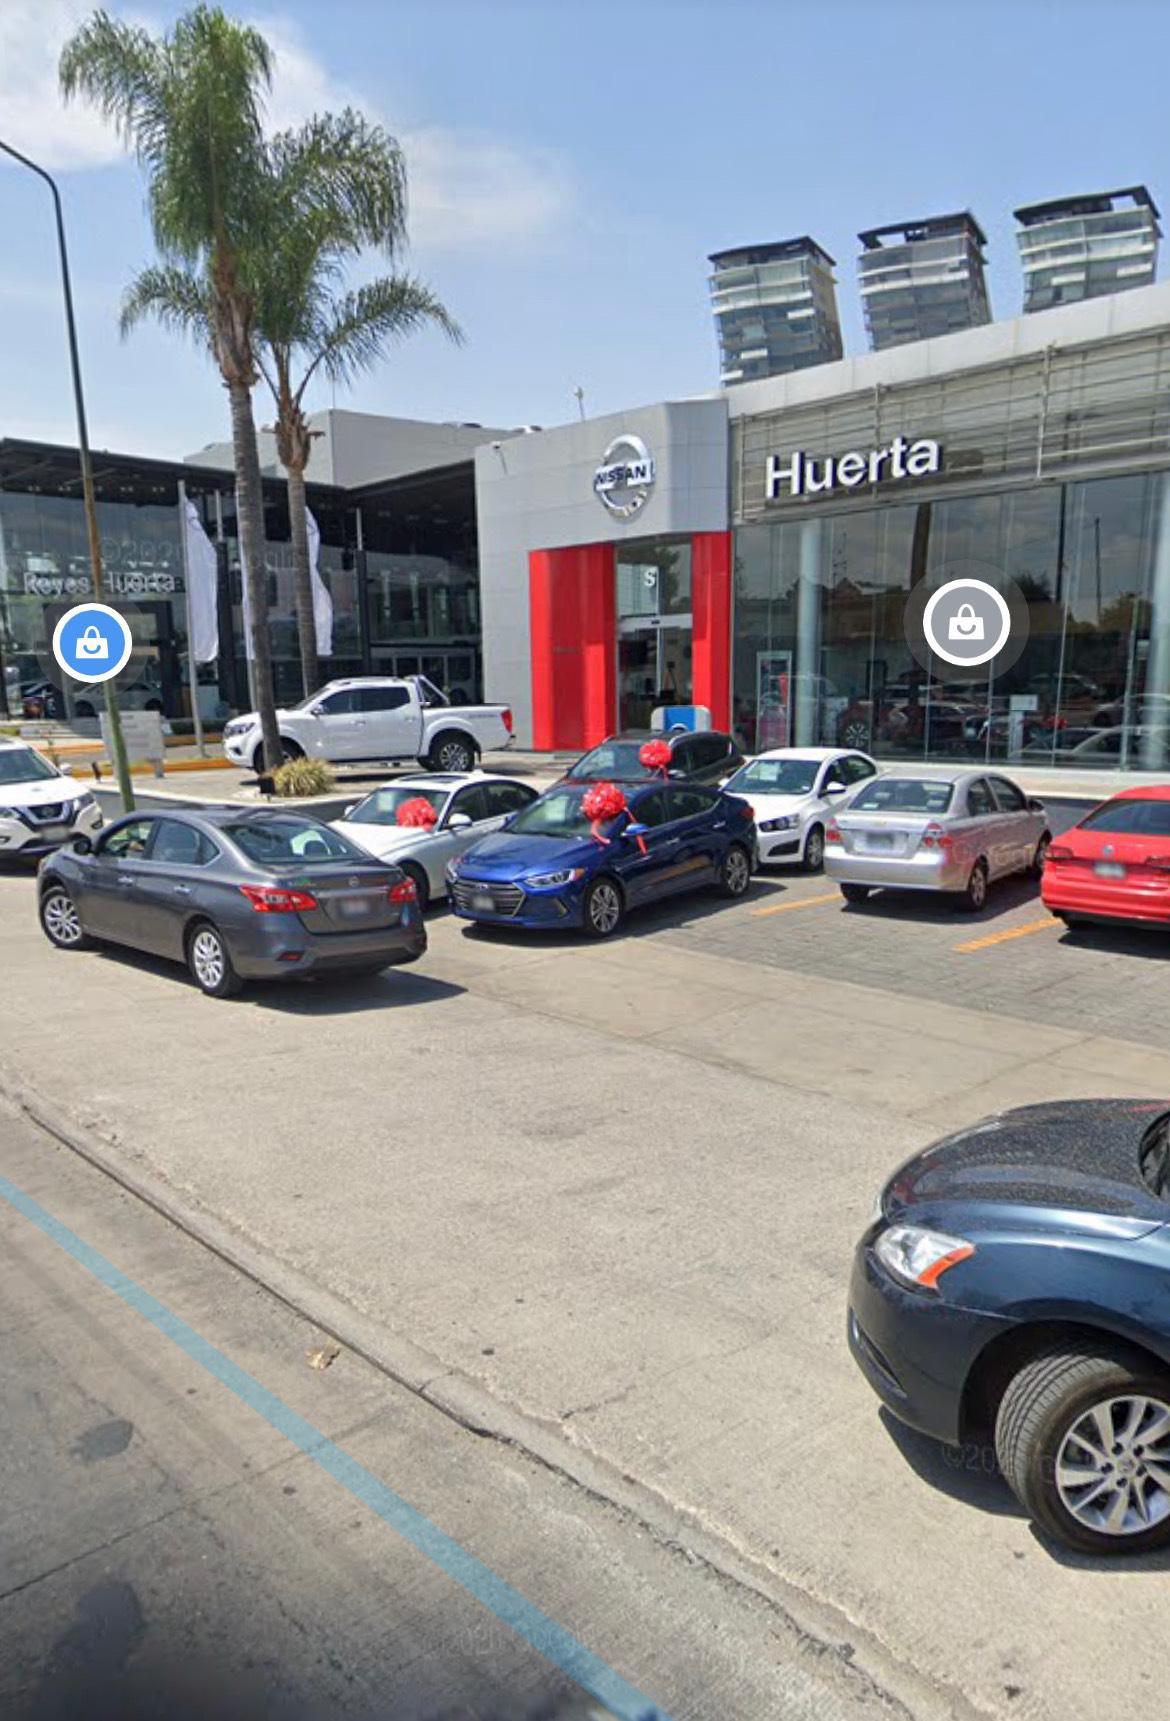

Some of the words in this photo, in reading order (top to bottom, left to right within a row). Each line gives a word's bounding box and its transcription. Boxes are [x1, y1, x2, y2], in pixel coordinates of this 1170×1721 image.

[595, 463, 649, 485] NISSAN
[765, 436, 942, 499] Huerta
[23, 572, 91, 597] Reyes
